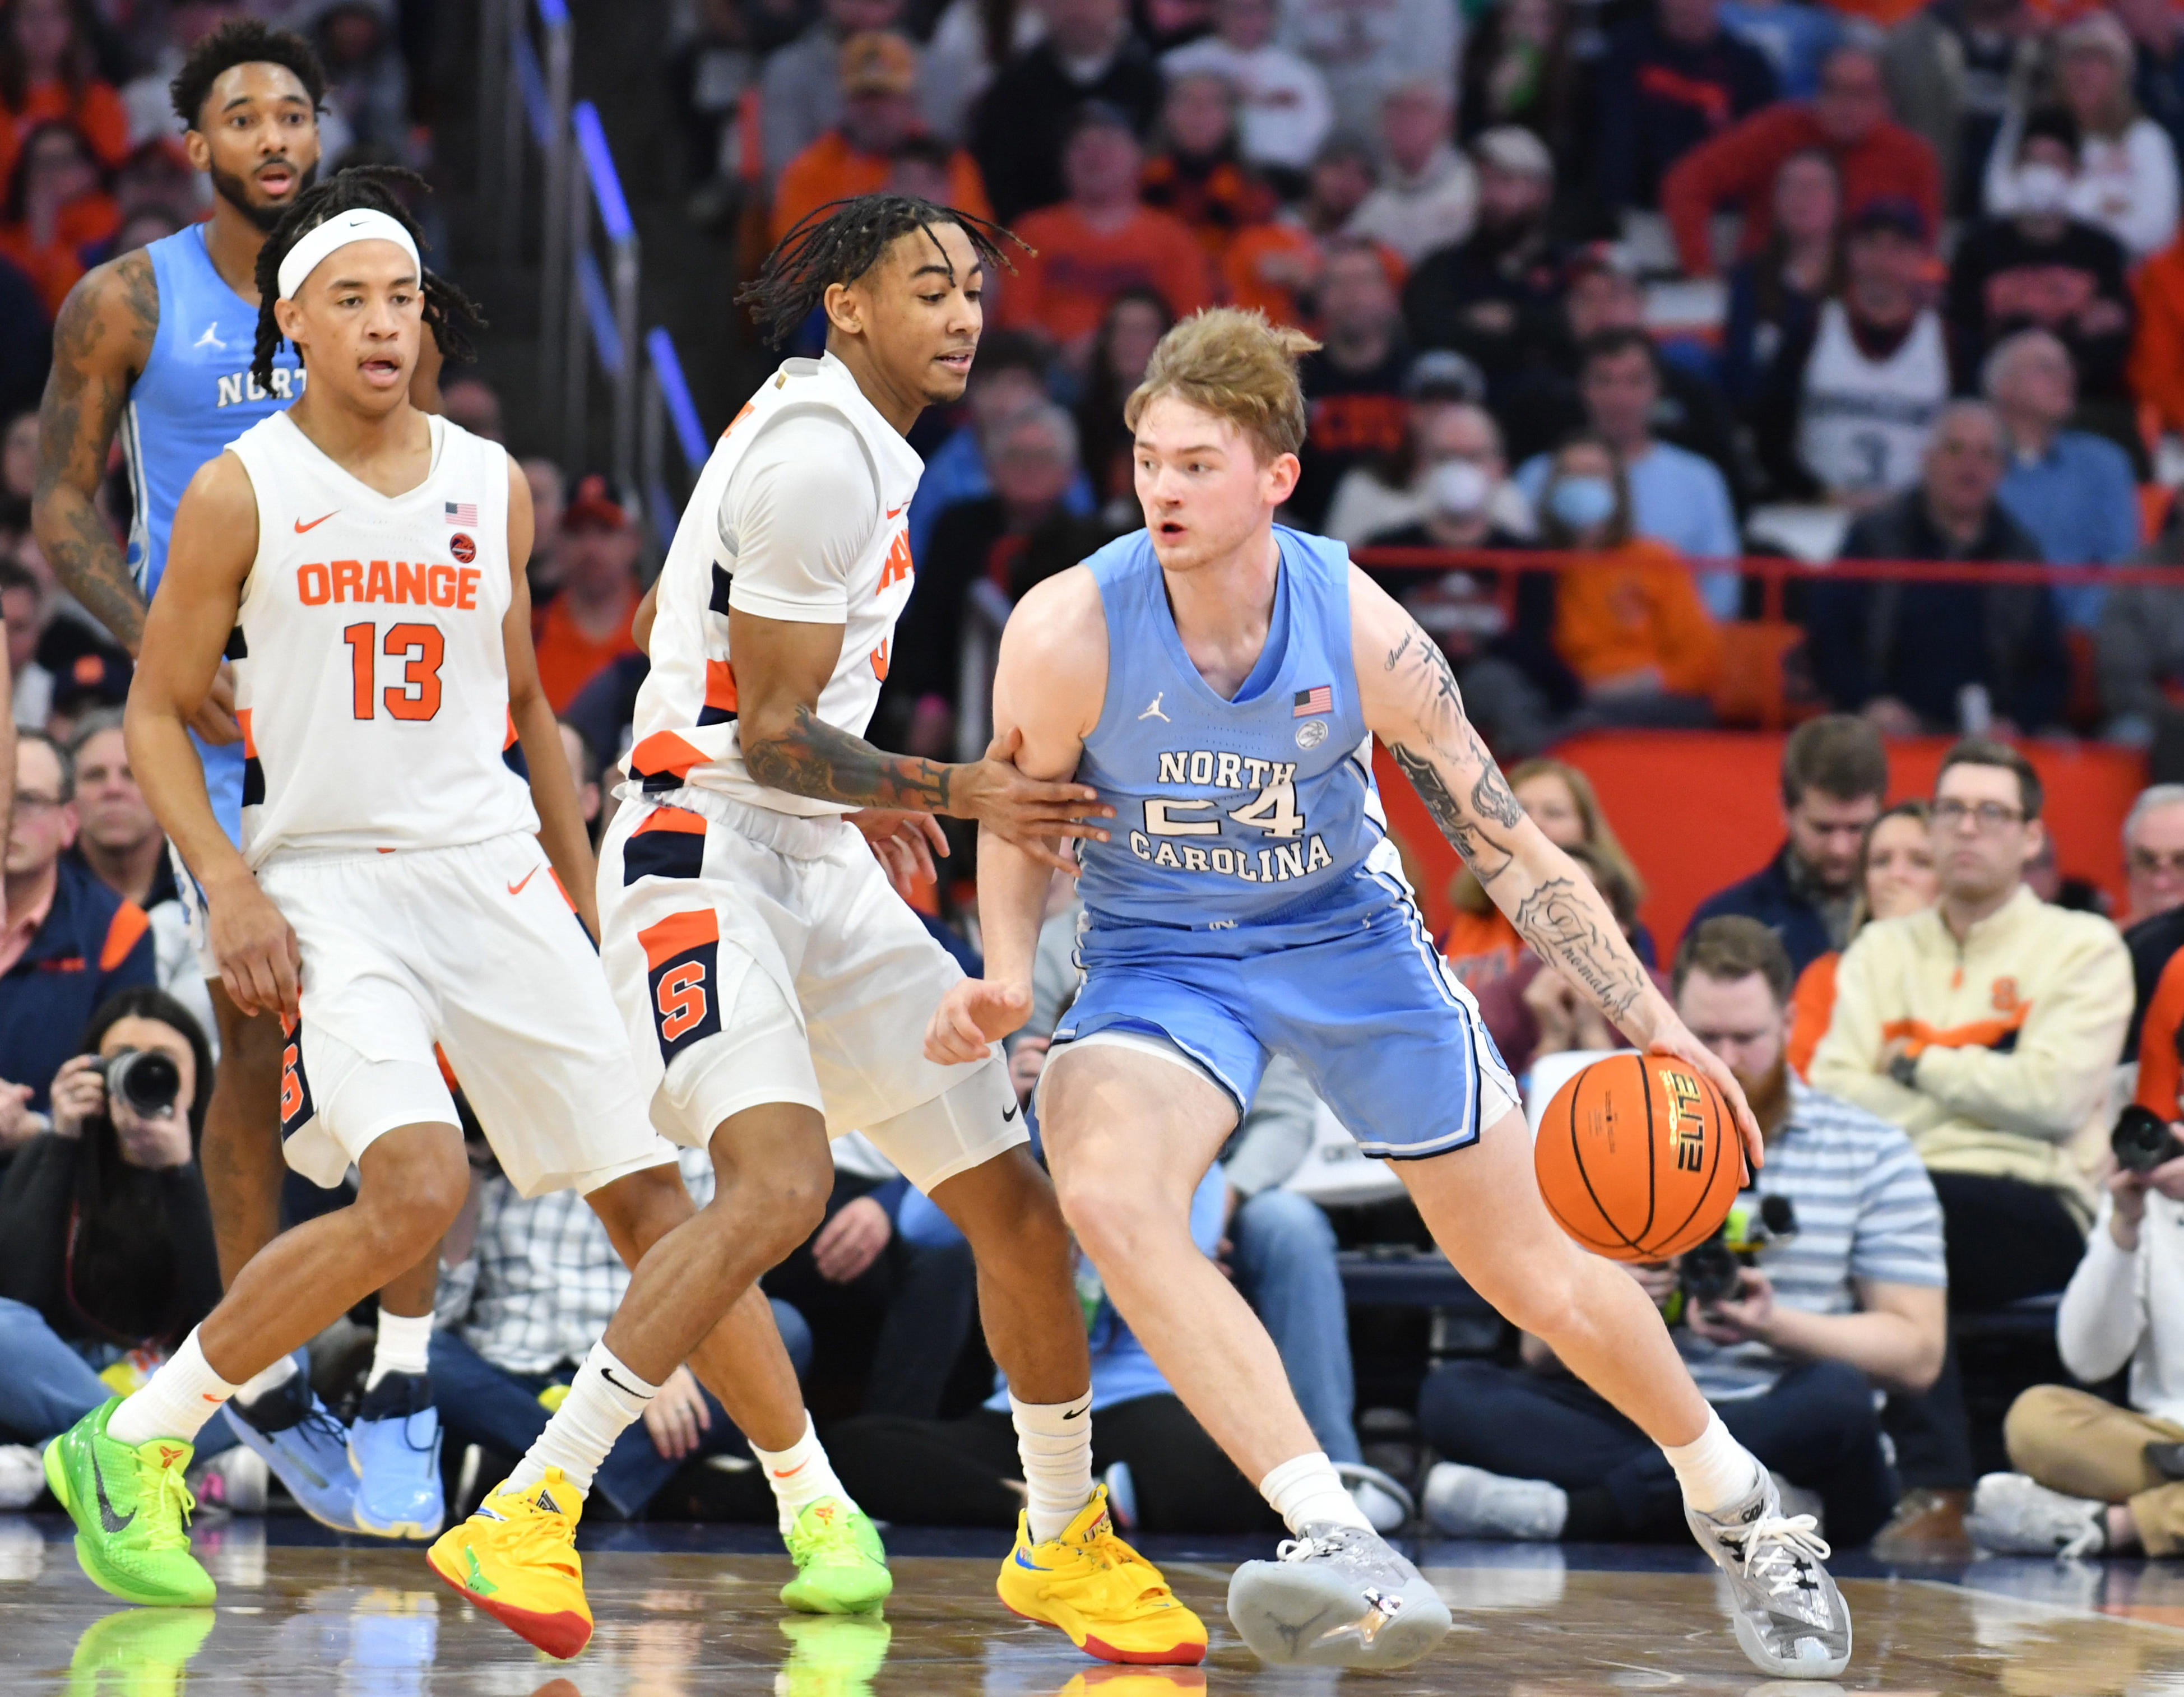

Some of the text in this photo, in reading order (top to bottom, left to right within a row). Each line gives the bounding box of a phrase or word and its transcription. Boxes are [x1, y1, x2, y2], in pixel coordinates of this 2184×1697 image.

[216, 368, 308, 408] NORT
[296, 560, 481, 610] ORANGE
[344, 622, 445, 721] 13
[1157, 750, 1297, 790] NORTH
[1142, 781, 1306, 840] 24
[1129, 829, 1334, 884] CAROLINA
[656, 960, 708, 1043] S
[1671, 1071, 1705, 1173] ELITE
